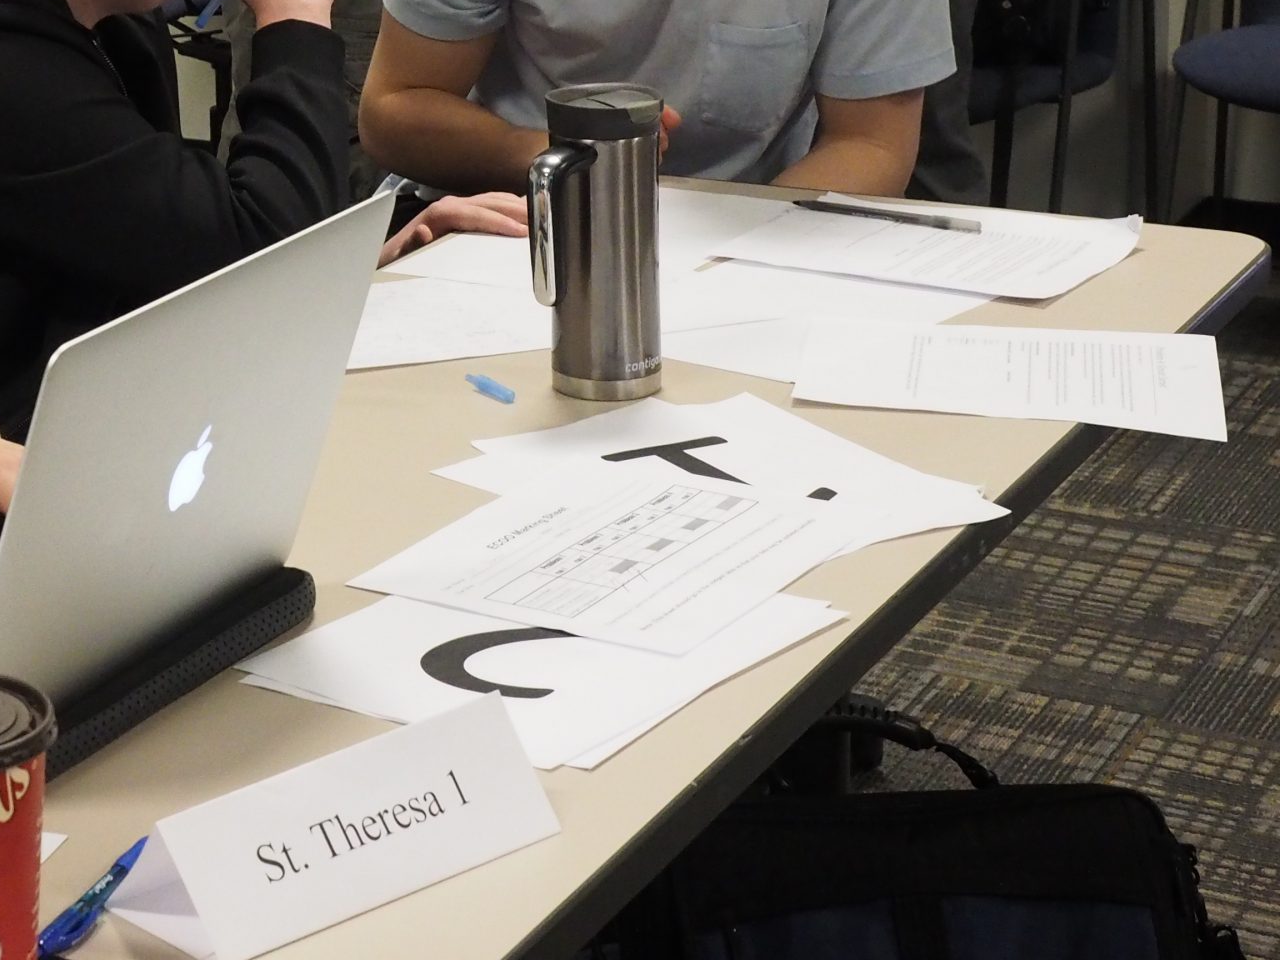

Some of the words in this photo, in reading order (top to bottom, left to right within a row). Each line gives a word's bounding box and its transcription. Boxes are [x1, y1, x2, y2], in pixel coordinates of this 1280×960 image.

[625, 355, 659, 373] contigo
[257, 842, 309, 883] St.
[309, 791, 446, 859] Theresa
